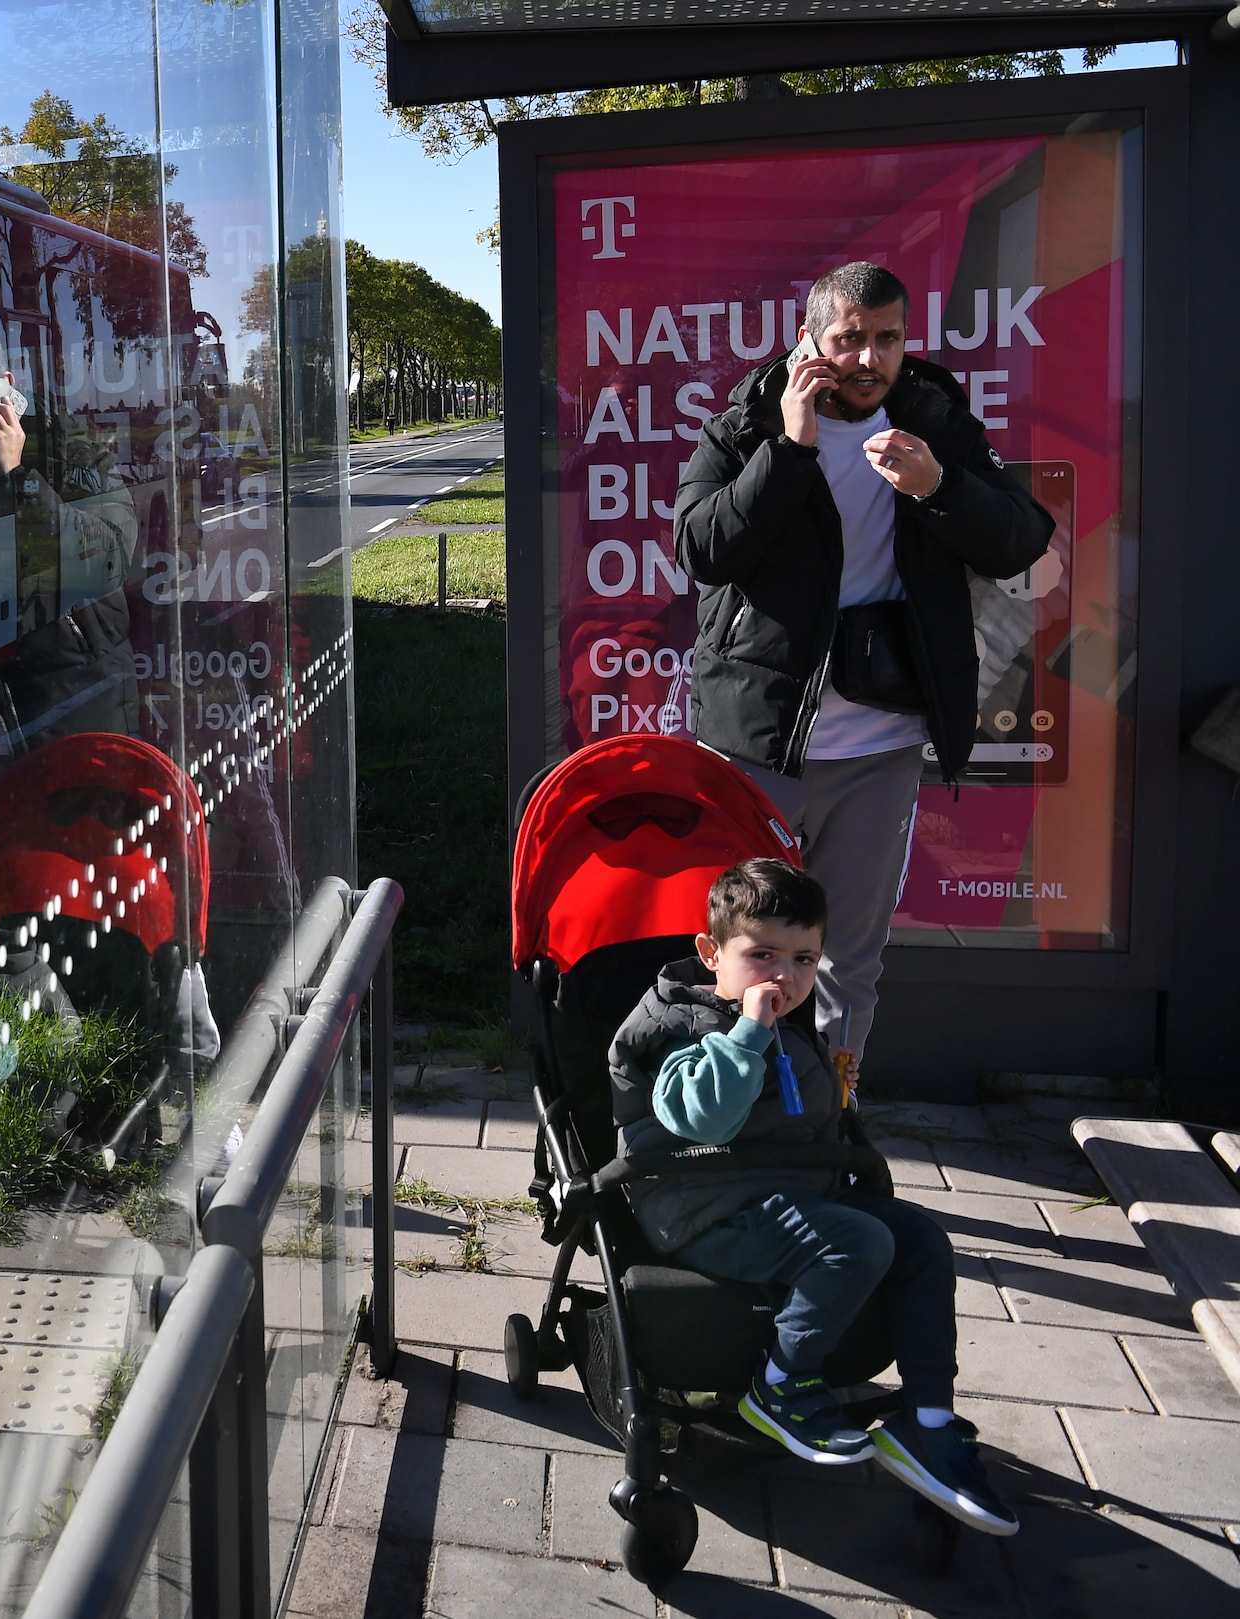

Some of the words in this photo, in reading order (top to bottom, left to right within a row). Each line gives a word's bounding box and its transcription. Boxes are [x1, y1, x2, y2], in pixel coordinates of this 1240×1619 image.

[583, 382, 714, 445] ALS
[591, 694, 694, 733] Pixel
[937, 879, 1068, 900] T-MOBILE.NL
